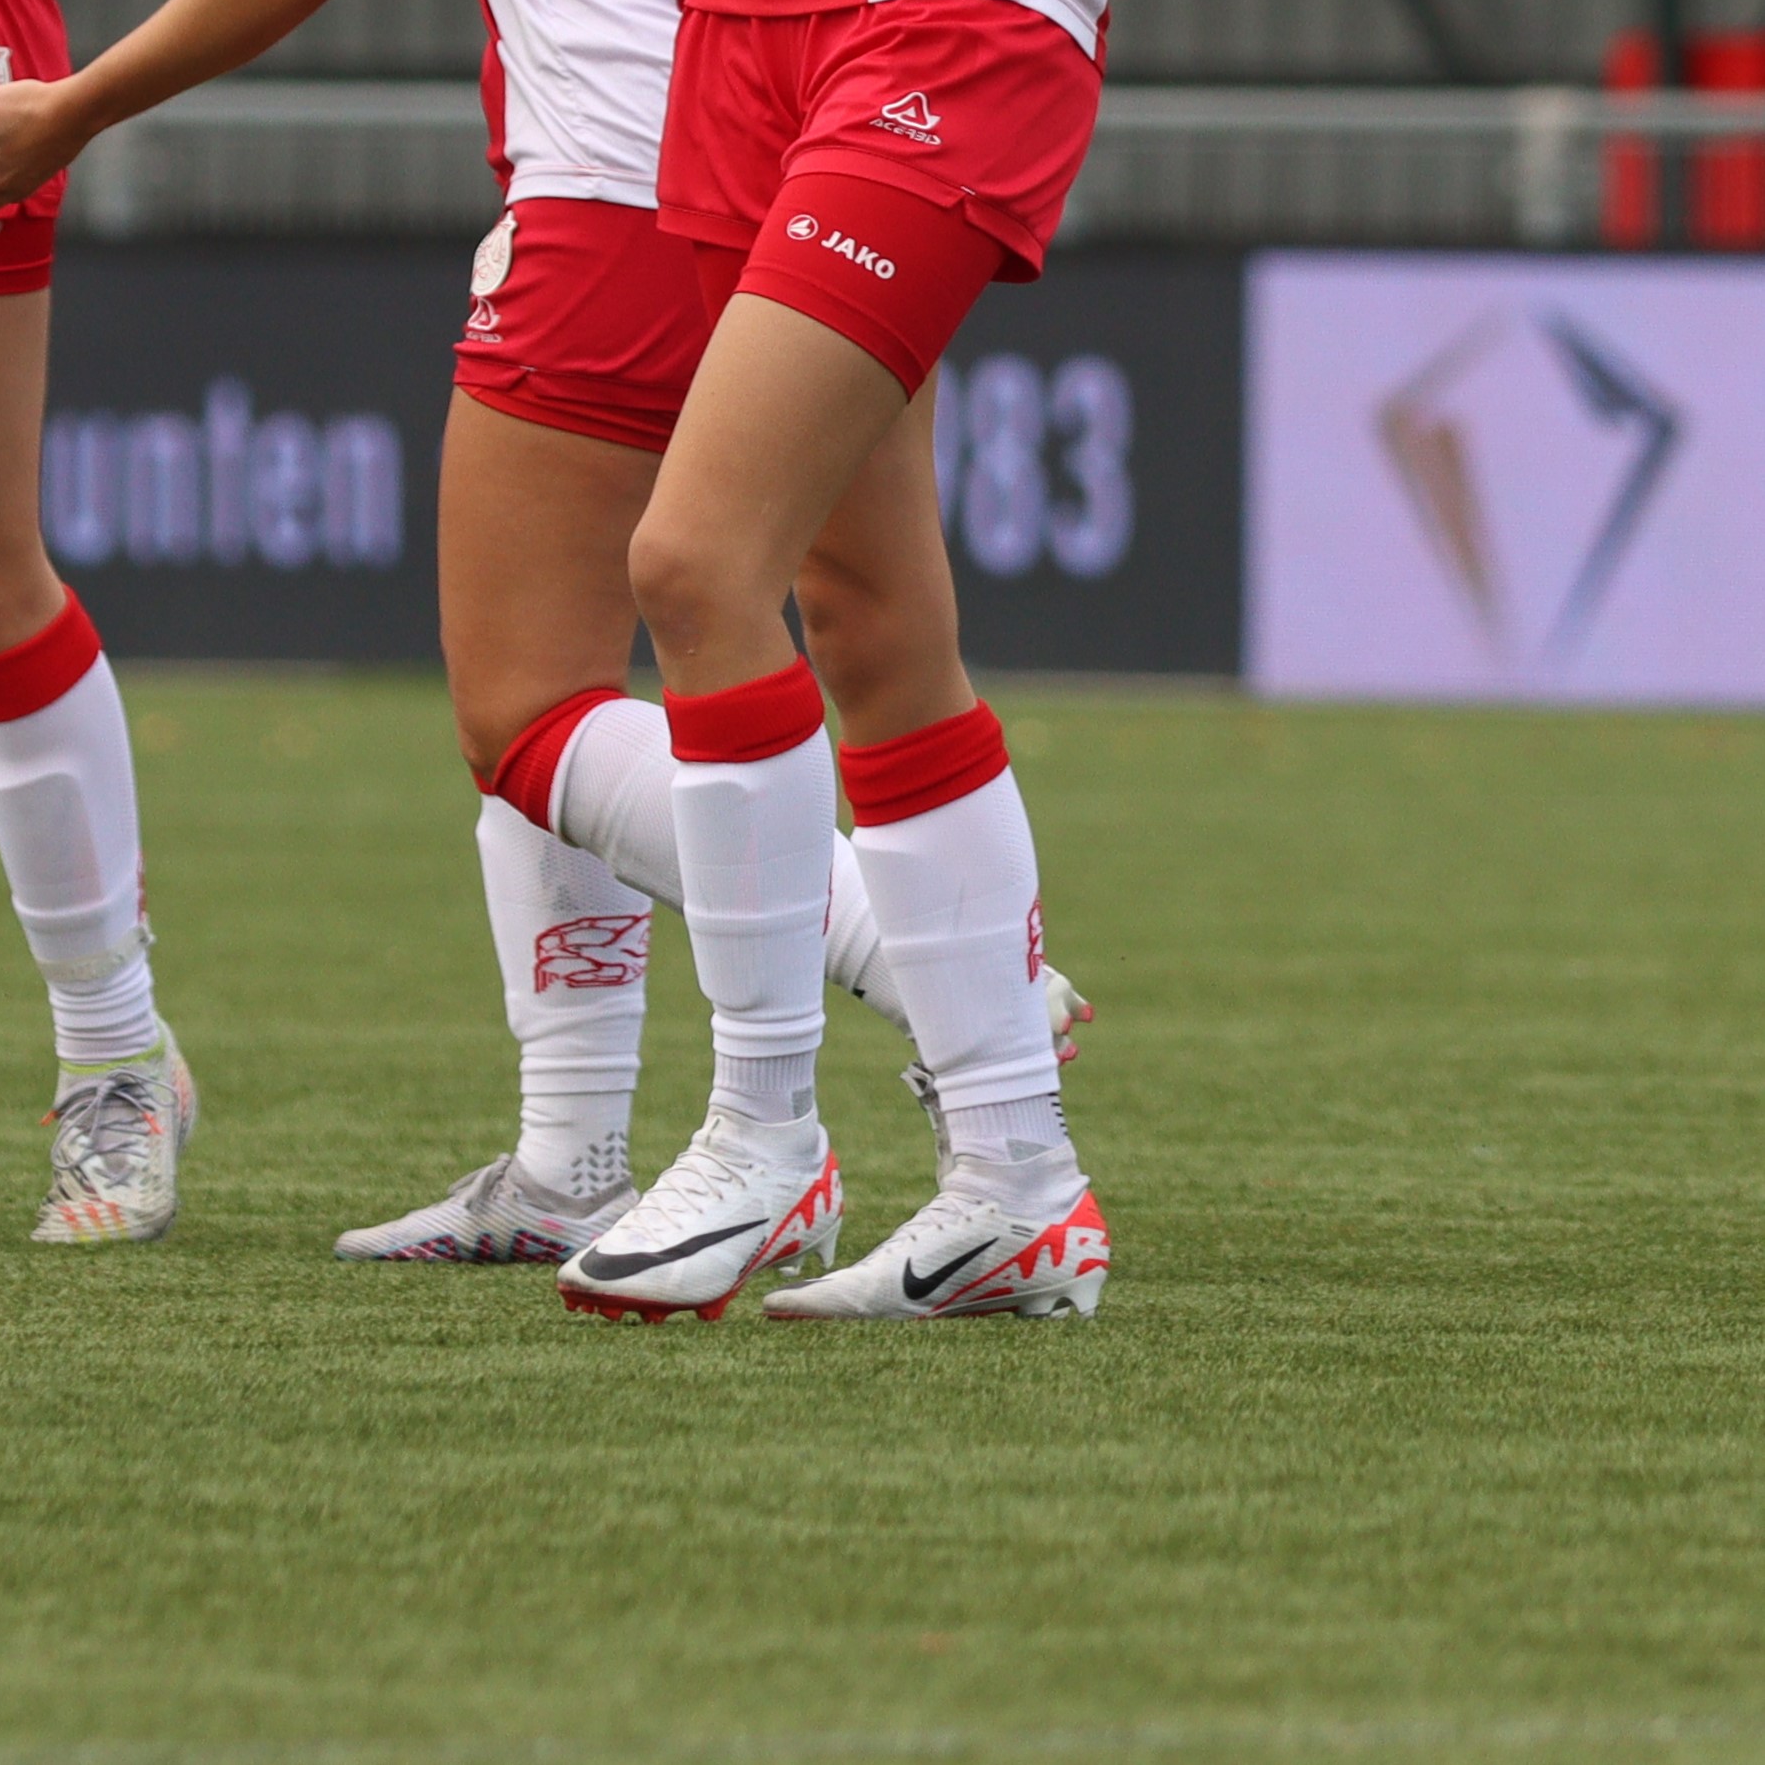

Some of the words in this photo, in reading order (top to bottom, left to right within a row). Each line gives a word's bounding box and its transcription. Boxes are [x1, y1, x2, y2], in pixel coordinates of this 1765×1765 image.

[820, 230, 896, 280] JAKO
[40, 376, 408, 570] unten
[934, 350, 1136, 580] 83
